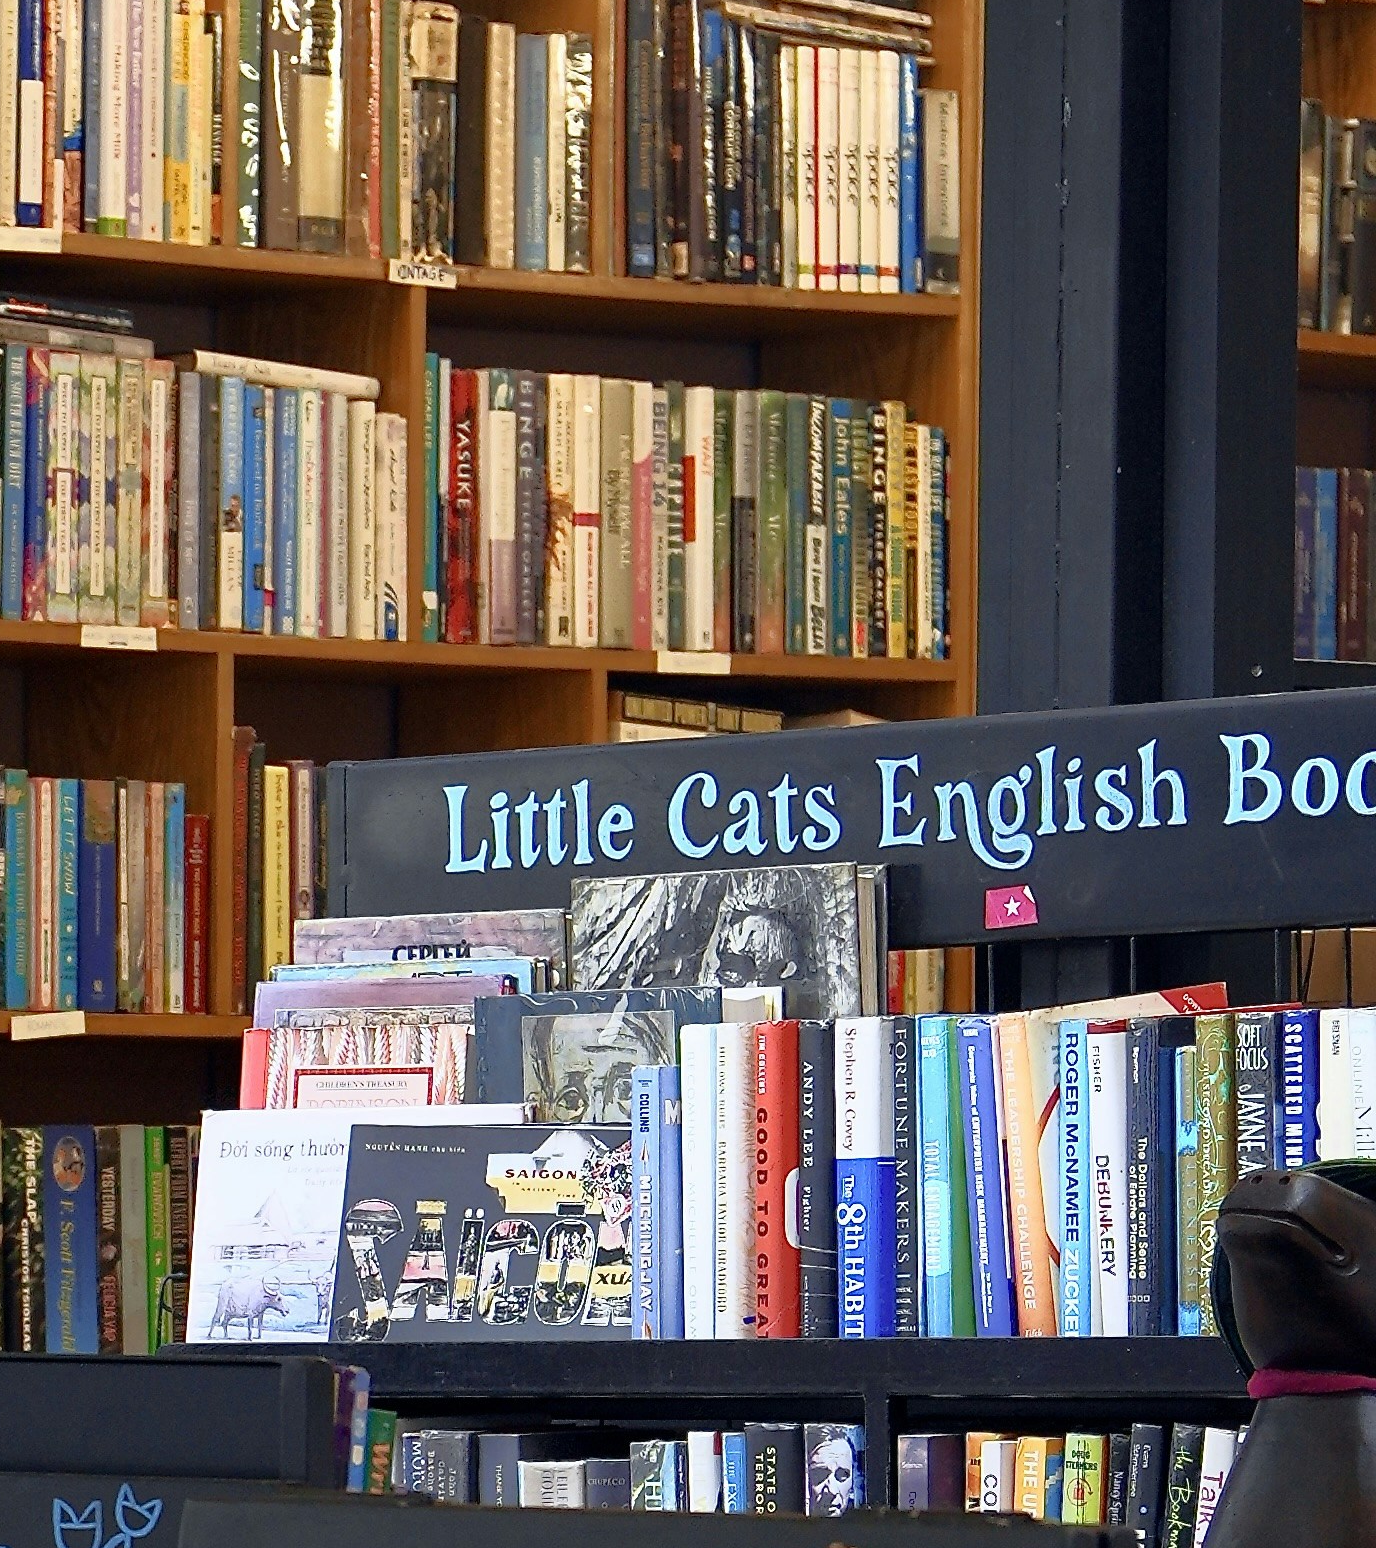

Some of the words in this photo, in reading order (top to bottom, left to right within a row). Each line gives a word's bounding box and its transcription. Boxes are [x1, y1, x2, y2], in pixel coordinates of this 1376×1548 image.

[395, 263, 447, 285] VINTAGE
[519, 379, 533, 481] BINGE
[834, 414, 848, 479] John
[455, 421, 472, 510] YASUKE
[443, 776, 636, 874] Little
[669, 771, 842, 857] Cats
[877, 738, 1189, 870] English
[843, 1027, 857, 1087] Stephen
[894, 1027, 908, 1147] FORTUNE
[1066, 1032, 1080, 1116] ROGER
[1284, 1022, 1303, 1116] SCATTERED
[639, 1093, 650, 1133] COLLINS
[802, 1060, 815, 1120] ANDY
[845, 1091, 857, 1104] R.
[756, 1107, 769, 1186] GOOD
[802, 1128, 814, 1168] LEE
[842, 1106, 857, 1152] Covey
[503, 1167, 579, 1180] SAIGON
[839, 1174, 854, 1199] The
[1065, 1125, 1080, 1242] McNAMEE
[639, 1174, 654, 1312] MOCKINGJAY
[756, 1200, 769, 1238] TO
[836, 1202, 866, 1246] 8th
[894, 1160, 910, 1264] MAKERS
[1095, 1154, 1117, 1277] DEBUNKERY
